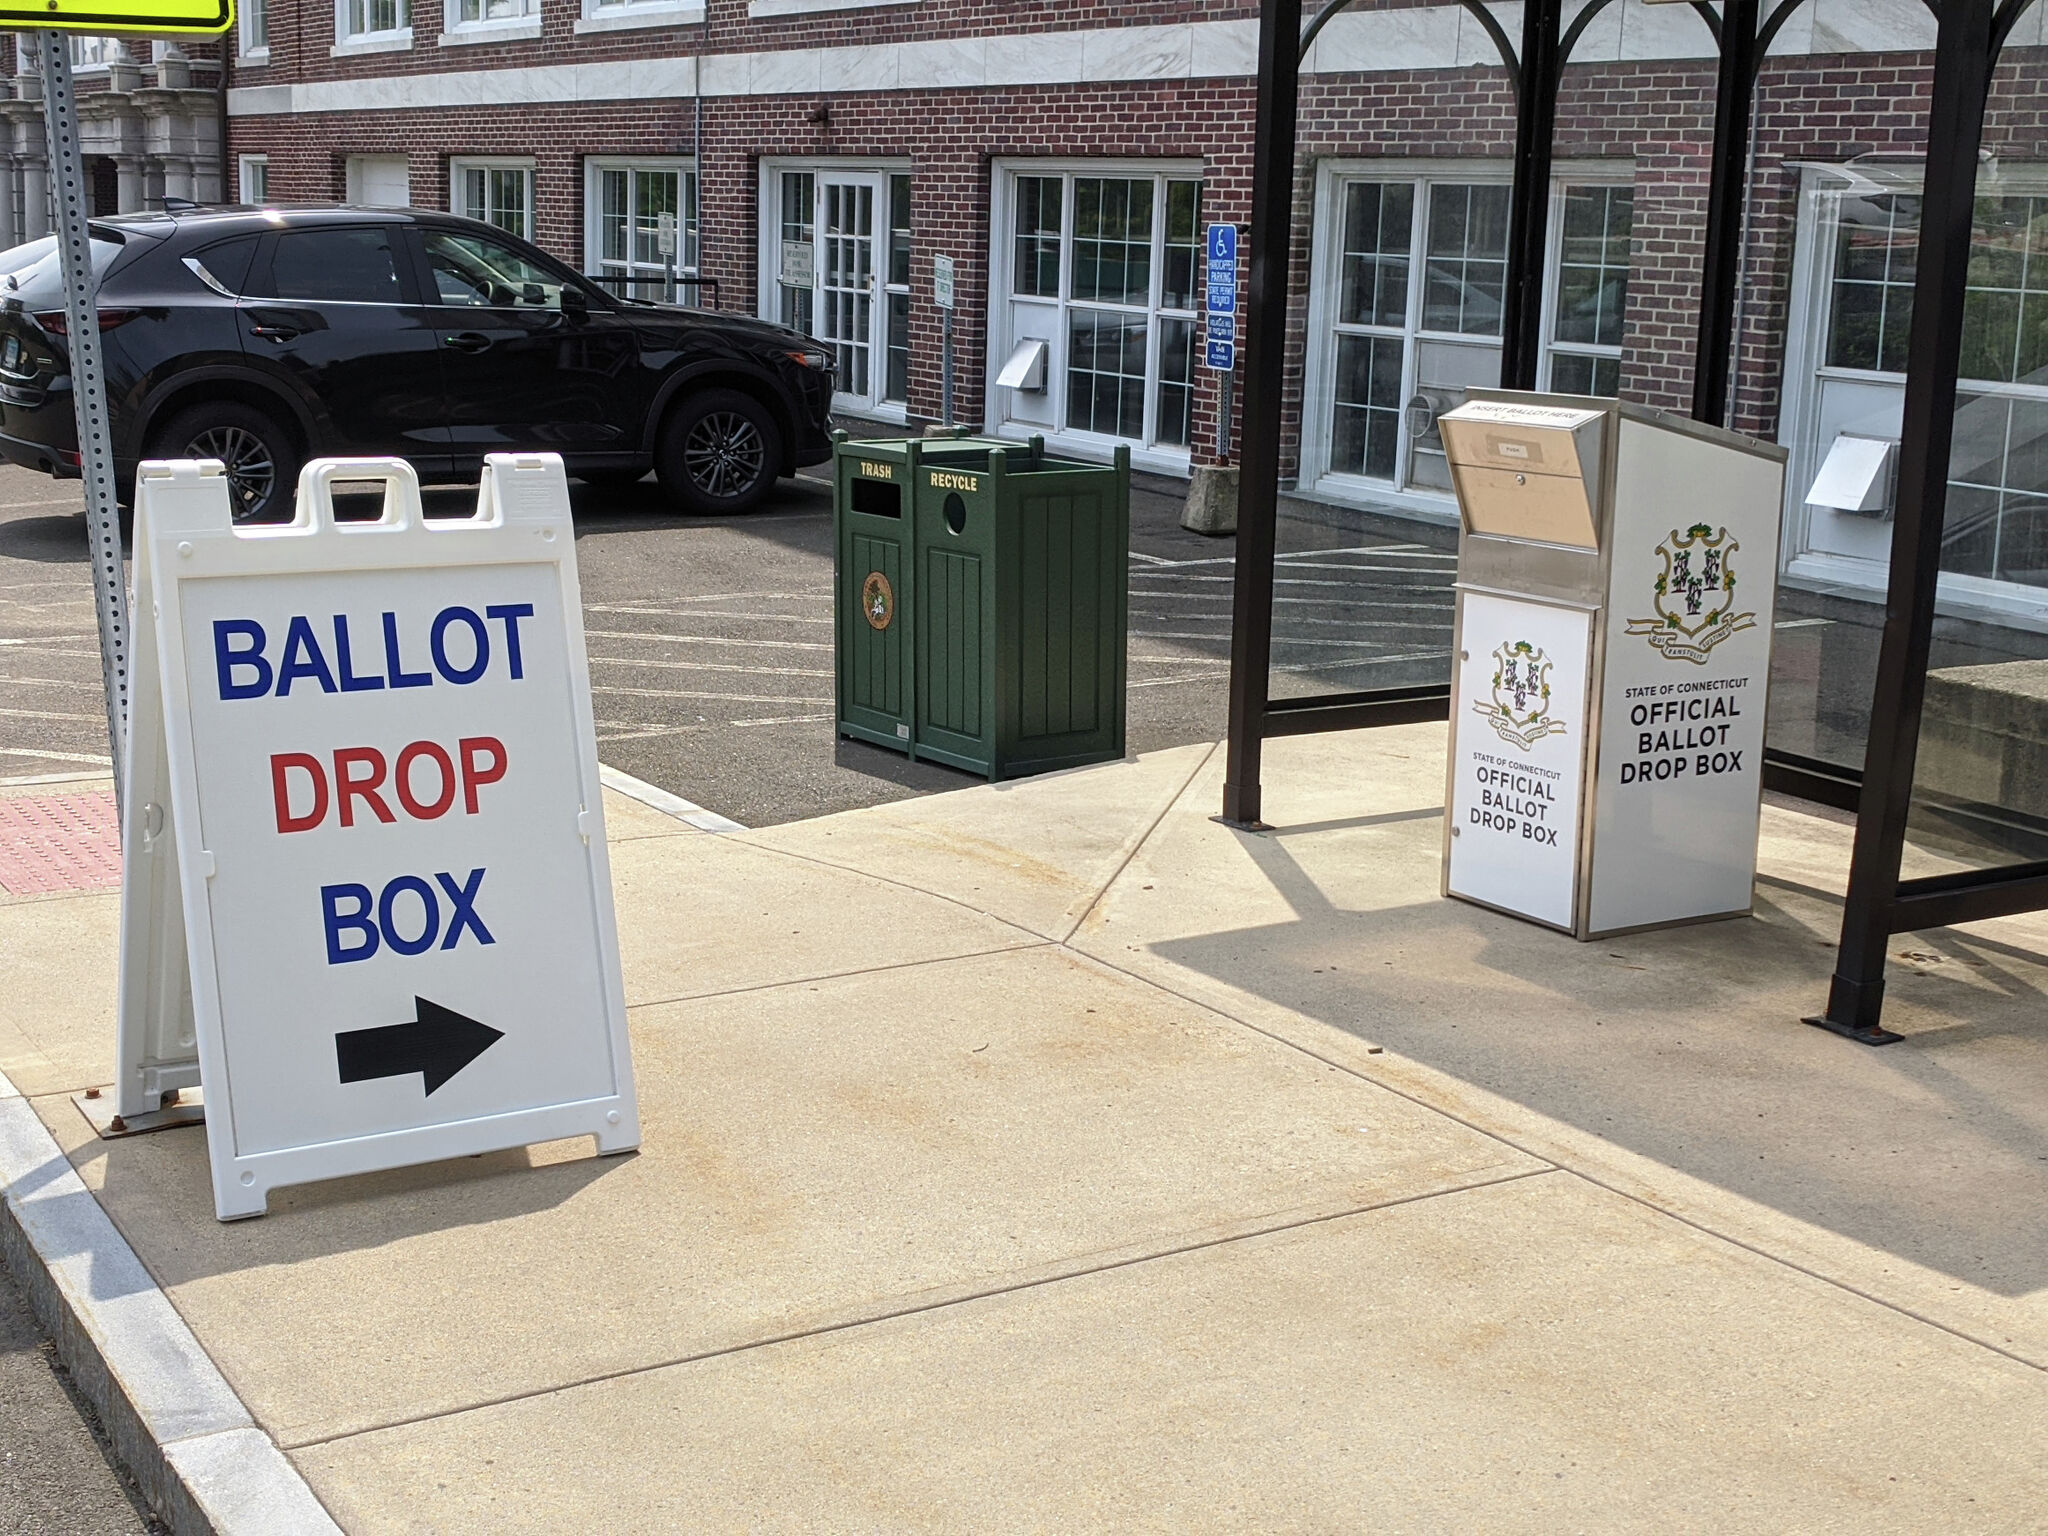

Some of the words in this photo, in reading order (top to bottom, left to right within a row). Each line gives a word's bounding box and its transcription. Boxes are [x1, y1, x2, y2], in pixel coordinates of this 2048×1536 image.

[1211, 271, 1232, 283] PARKING
[1507, 408, 1548, 416] BALLOT
[1548, 411, 1580, 419] HERE
[861, 462, 892, 479] TRASH
[930, 472, 977, 491] RECYCLE
[212, 602, 535, 701] BALLOT
[1652, 636, 1665, 644] QUI
[1664, 646, 1703, 660] TRANSTULIT
[1625, 686, 1657, 698] STATE
[1660, 684, 1674, 695] OF
[1677, 677, 1749, 694] CONNECTICUT
[1631, 696, 1740, 726] OFFICIAL
[1638, 724, 1731, 754] BALLOT
[1473, 752, 1495, 764] STATE
[1496, 757, 1507, 767] OF
[1508, 761, 1561, 780] CONNECTICUT
[1620, 757, 1687, 785] DROP
[1695, 750, 1743, 776] BOX
[270, 736, 507, 834] DROP
[1477, 766, 1555, 802] OFFICIAL
[1482, 789, 1548, 821] BALLOT
[1470, 807, 1516, 834] DROP
[1522, 821, 1558, 847] BOX
[320, 867, 496, 965] BOX
